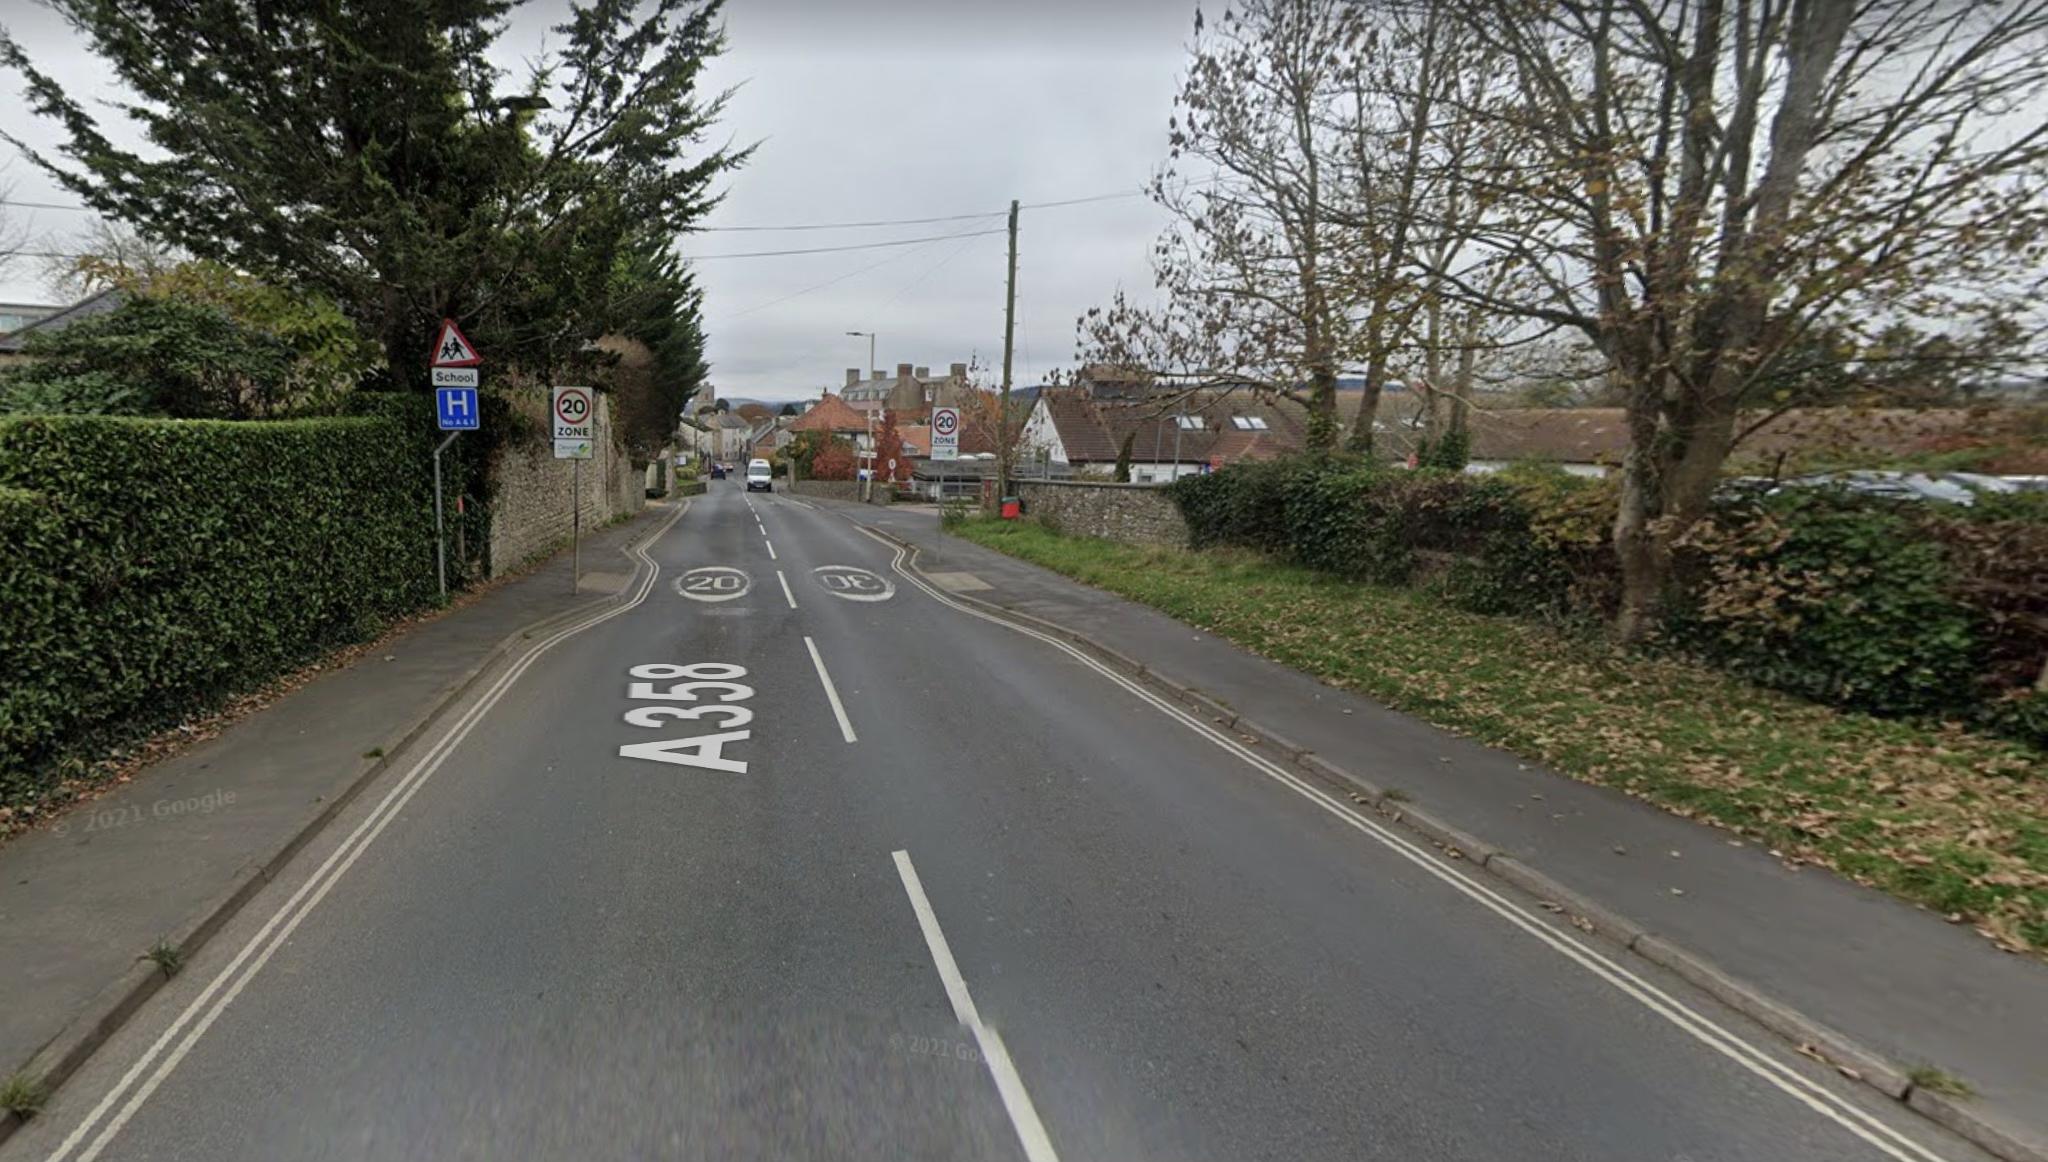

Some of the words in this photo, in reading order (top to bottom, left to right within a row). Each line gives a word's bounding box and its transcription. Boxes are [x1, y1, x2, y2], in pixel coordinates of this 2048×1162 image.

[436, 371, 475, 383] School
[446, 391, 469, 416] H
[561, 399, 586, 414] 20
[442, 418, 454, 426] No
[456, 418, 462, 426] A
[937, 415, 954, 429] 20
[558, 427, 589, 436] ZONE
[933, 436, 956, 445] ZONE
[686, 575, 740, 591] 20
[822, 573, 888, 591] 30
